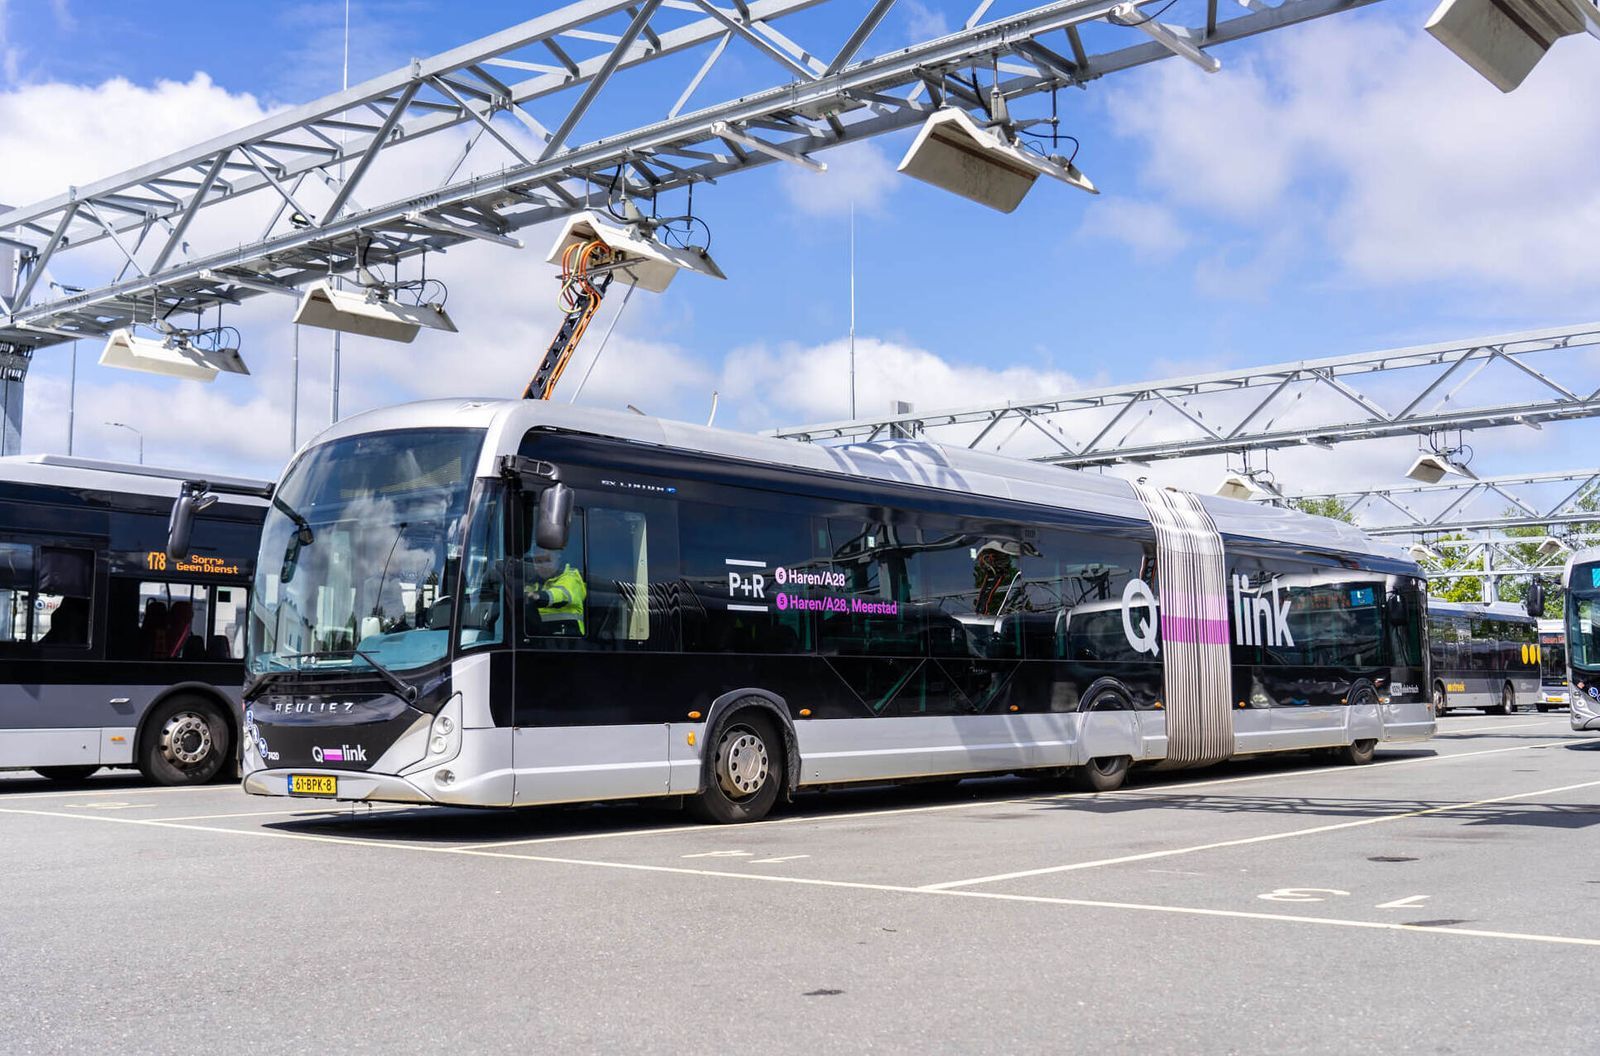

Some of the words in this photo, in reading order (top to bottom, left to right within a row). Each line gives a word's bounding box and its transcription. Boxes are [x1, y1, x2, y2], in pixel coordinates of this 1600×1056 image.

[147, 551, 166, 570] 178
[176, 562, 202, 572] Geen
[204, 564, 239, 574] Dienst
[728, 572, 765, 598] P+R
[788, 569, 845, 587] Haren/A28
[790, 595, 850, 615] Haren/A28,
[852, 598, 897, 615] Meerstad
[1121, 578, 1160, 657] Q
[1232, 574, 1295, 647] link
[312, 745, 323, 763] Q
[342, 744, 367, 761] link
[296, 778, 331, 791] 61-BPK-8
